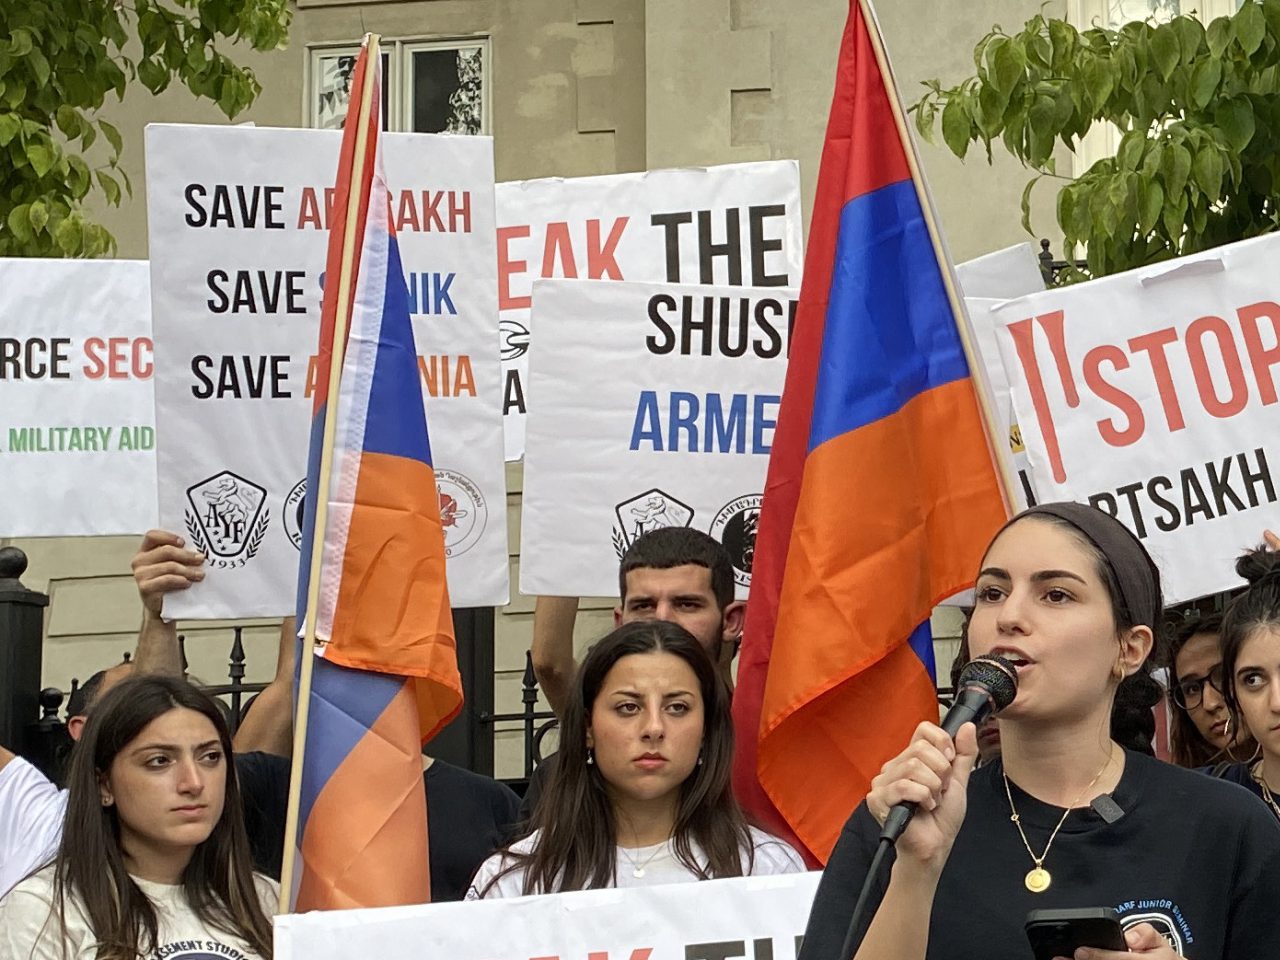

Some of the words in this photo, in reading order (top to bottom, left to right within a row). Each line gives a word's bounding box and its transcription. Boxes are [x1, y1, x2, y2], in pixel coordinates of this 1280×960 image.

[184, 184, 285, 229] SAVE
[650, 204, 788, 287] THE
[207, 270, 306, 314] SAVE
[83, 337, 154, 379] SEC
[191, 355, 291, 399] SAVE
[9, 427, 112, 452] MILITARY
[118, 426, 154, 451] AID
[629, 391, 781, 454] ARME
[204, 503, 247, 543] AYF
[209, 559, 246, 569] 1933
[1137, 899, 1173, 910] JUNIOR
